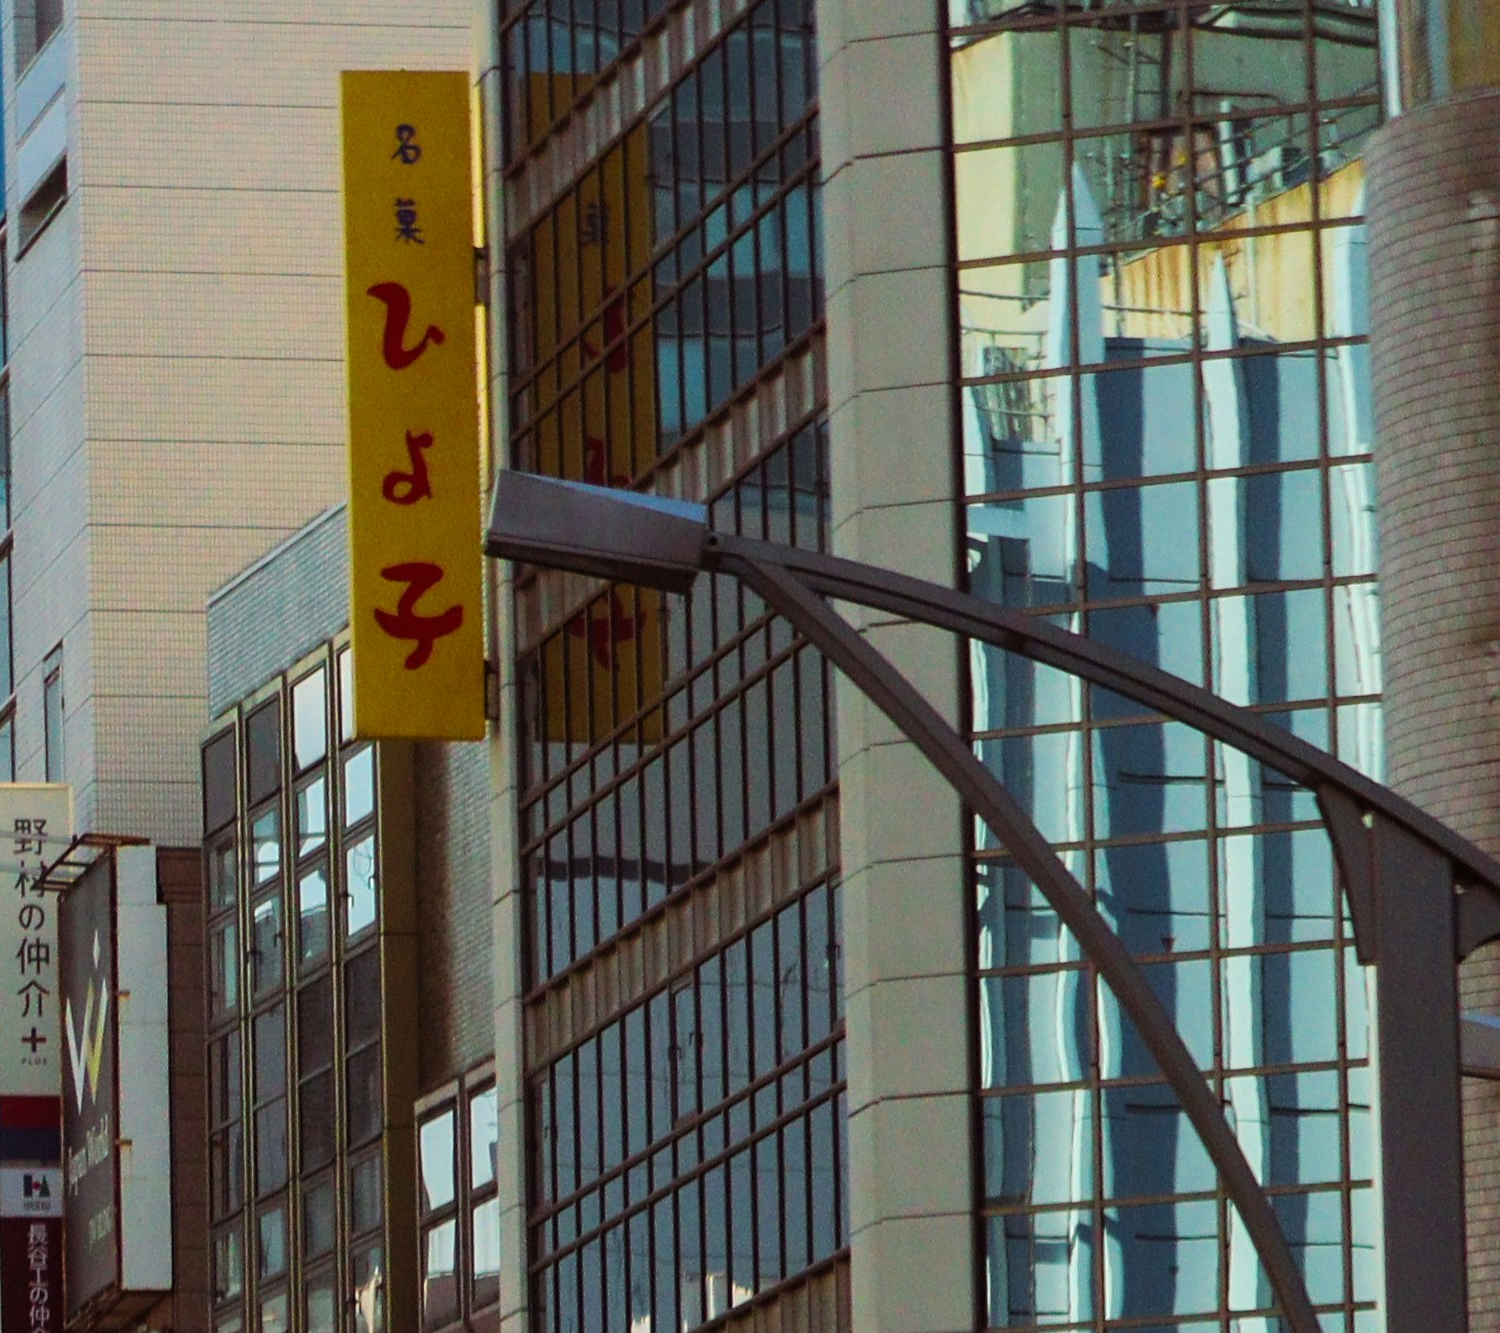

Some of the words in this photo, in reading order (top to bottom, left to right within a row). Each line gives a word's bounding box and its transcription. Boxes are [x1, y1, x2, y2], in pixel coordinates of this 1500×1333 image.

[391, 122, 426, 246] 名菓
[366, 281, 466, 672] ひよ子
